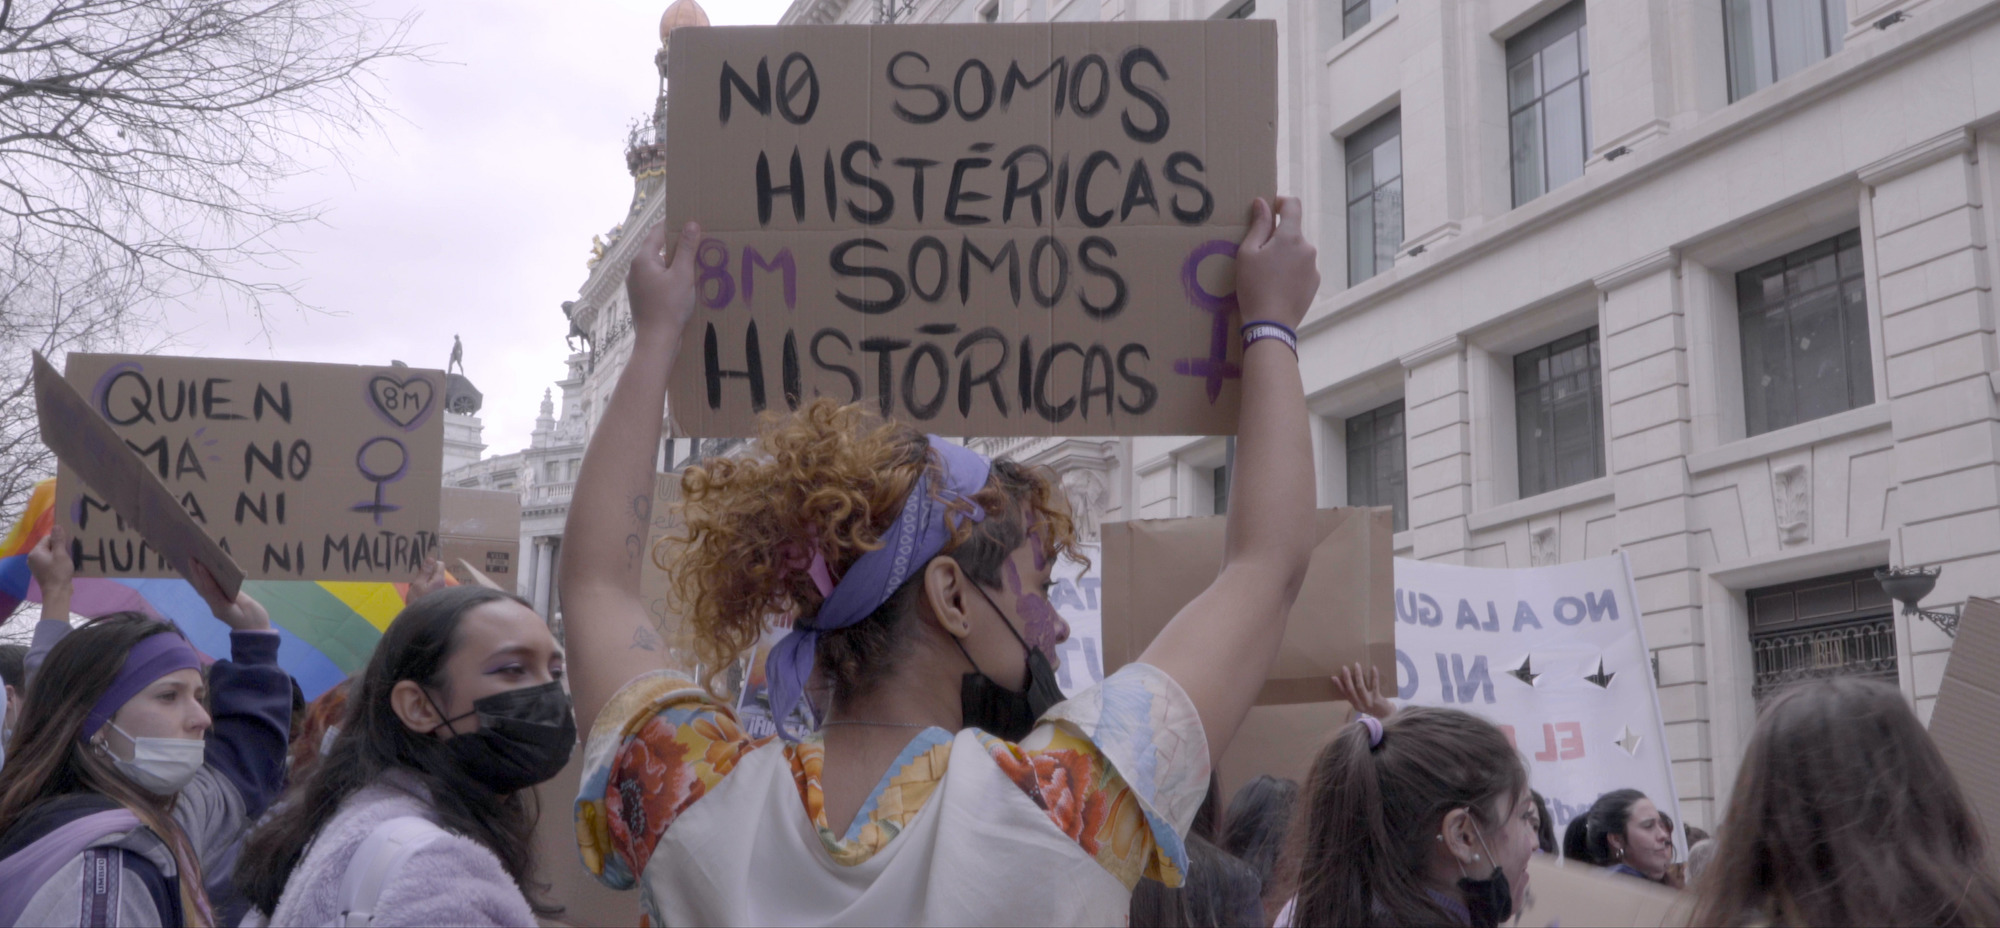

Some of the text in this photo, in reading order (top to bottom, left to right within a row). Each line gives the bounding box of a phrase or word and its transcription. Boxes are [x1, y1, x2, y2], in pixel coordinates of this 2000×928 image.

[885, 46, 1170, 144] SOMOS
[755, 140, 1215, 229] HISTÉRICAS
[696, 237, 797, 315] 8M
[829, 235, 1128, 321] SOMOS
[104, 370, 292, 426] QUIEN
[383, 386, 419, 411] 8M
[704, 317, 1158, 423] HISTÓRICAS
[125, 434, 207, 482] MA
[79, 491, 285, 530] MA NI
[263, 540, 305, 573] NI
[322, 530, 438, 574] MALTRATA
